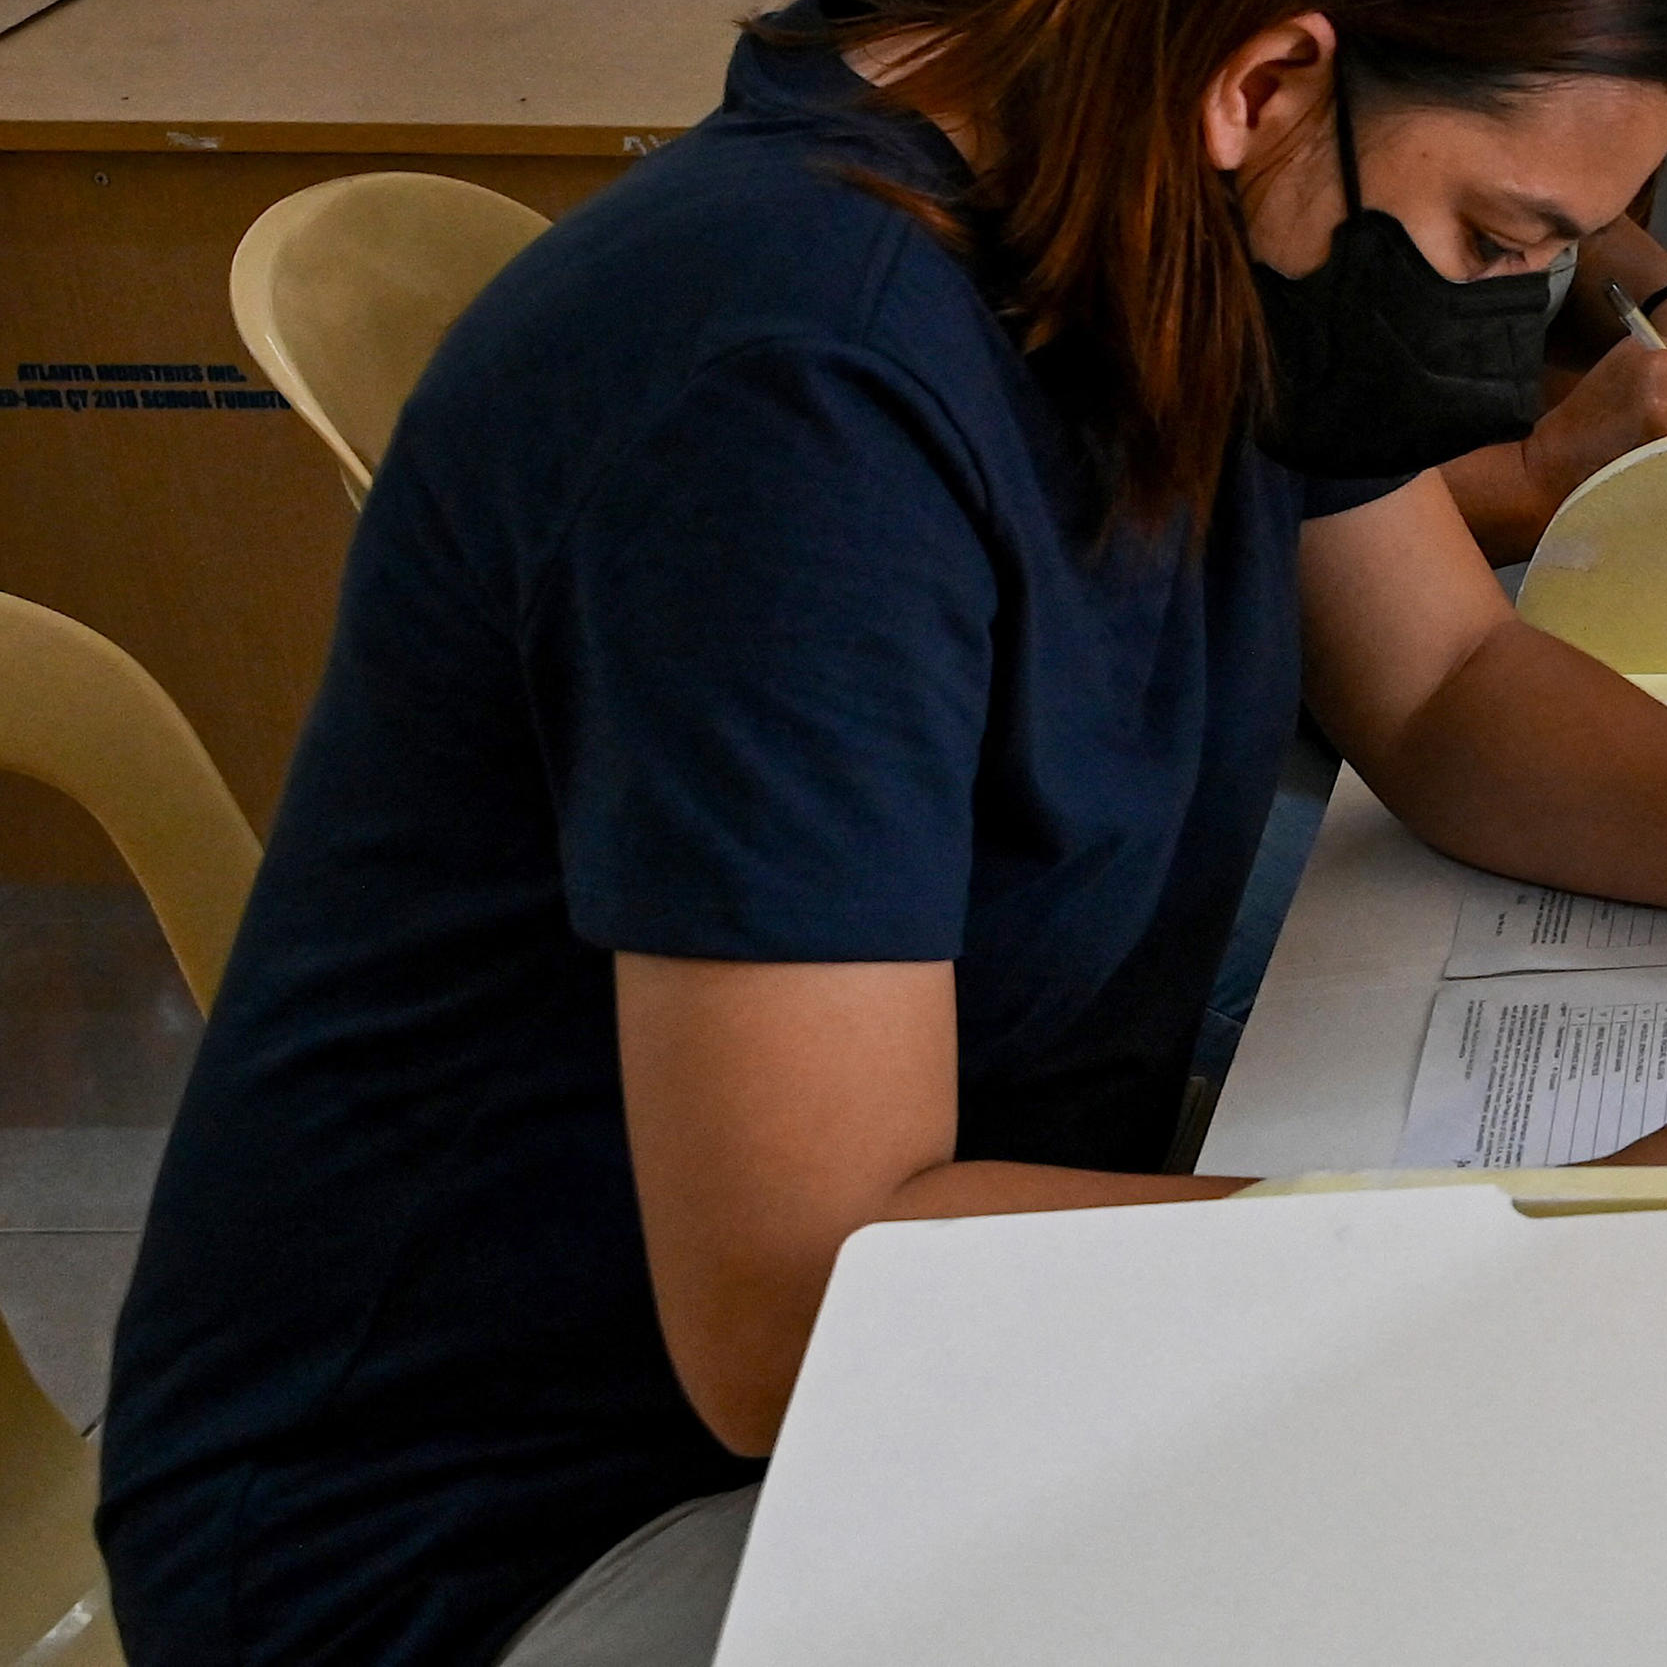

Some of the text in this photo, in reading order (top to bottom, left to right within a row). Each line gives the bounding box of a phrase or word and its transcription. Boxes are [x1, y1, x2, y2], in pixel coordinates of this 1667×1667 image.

[18, 364, 247, 382] ATLANTA INDUSTRIES INC.
[66, 389, 88, 412] CY
[141, 389, 212, 408] SCHOOL
